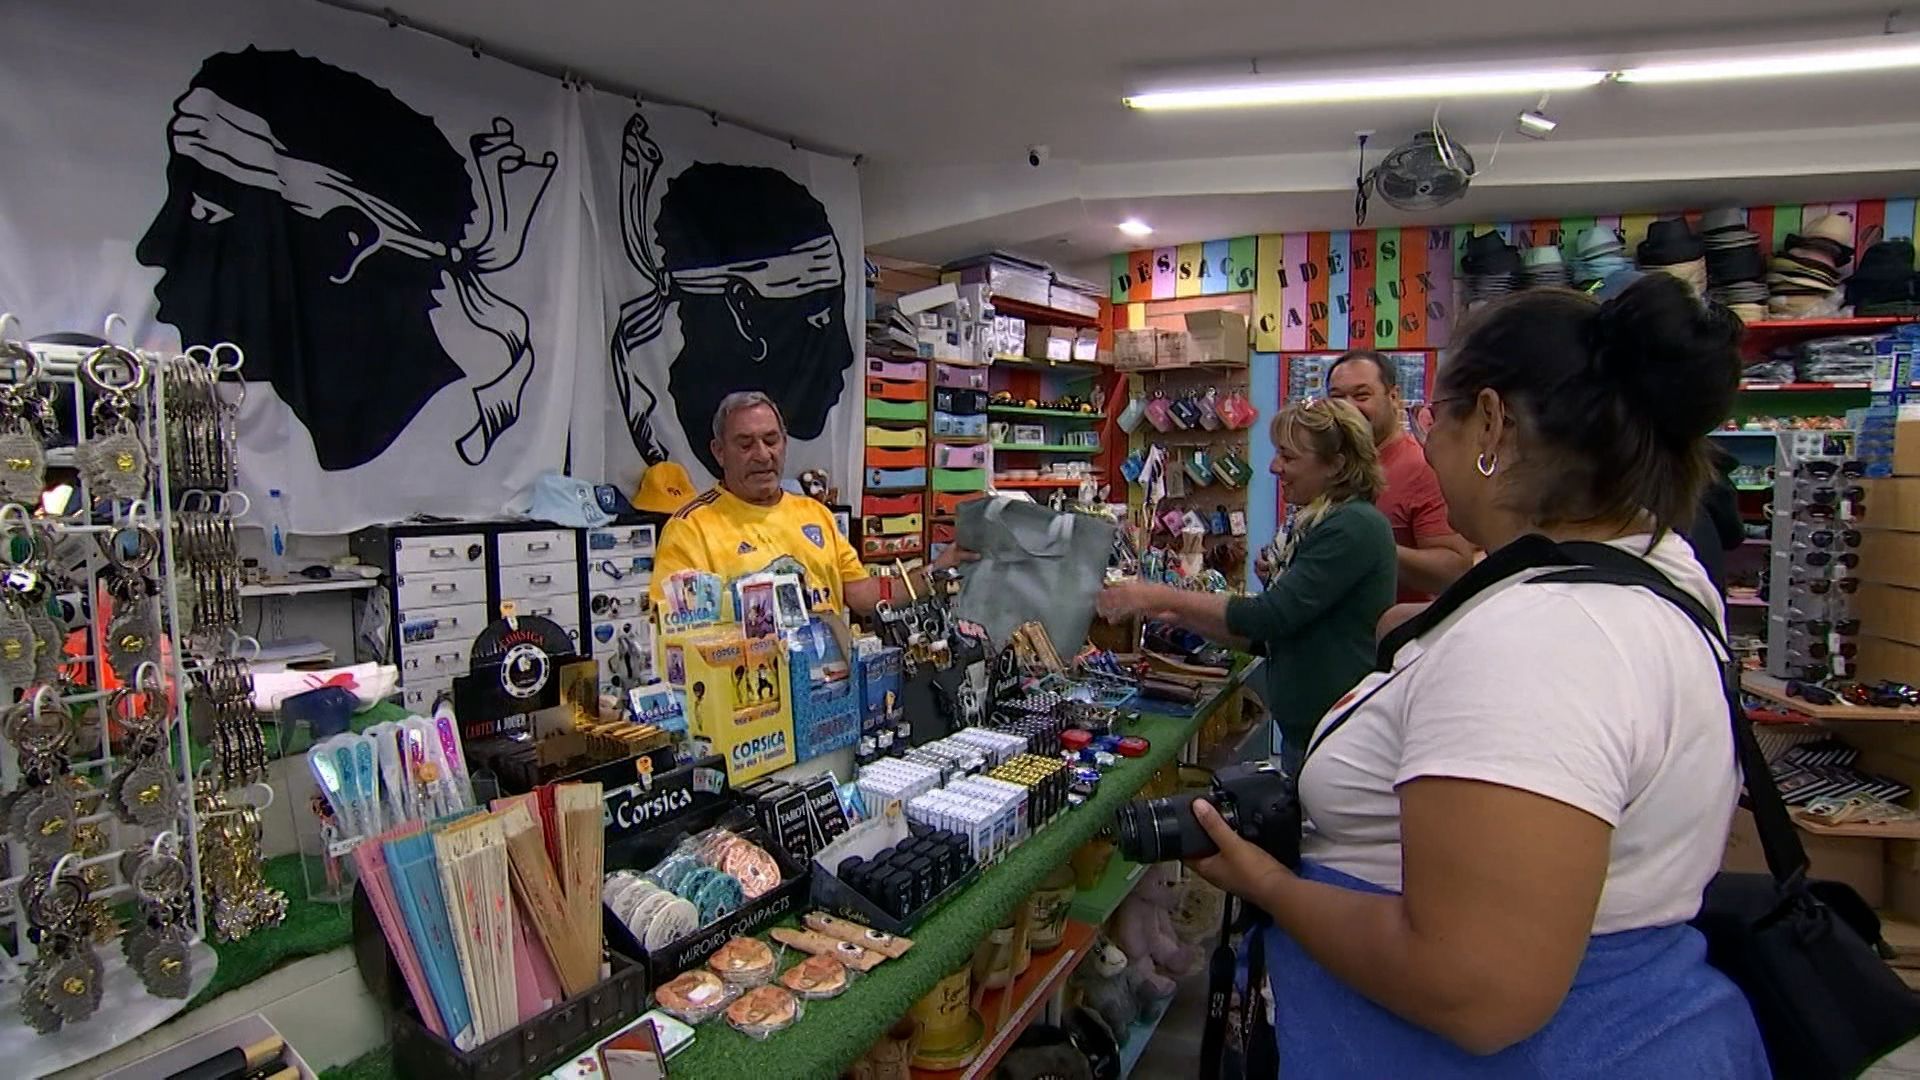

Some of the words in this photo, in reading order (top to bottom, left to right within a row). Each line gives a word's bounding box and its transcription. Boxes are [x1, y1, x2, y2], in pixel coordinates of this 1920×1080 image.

[1260, 272, 1437, 335] CADEAUX
[1350, 300, 1446, 341] GOGO
[732, 730, 786, 760] CORSICA
[616, 787, 693, 829] Corsica
[780, 804, 806, 825] TAROT
[811, 790, 837, 810] TAROT
[678, 928, 726, 968] MIROIRS
[729, 896, 791, 940] COMPACTS
